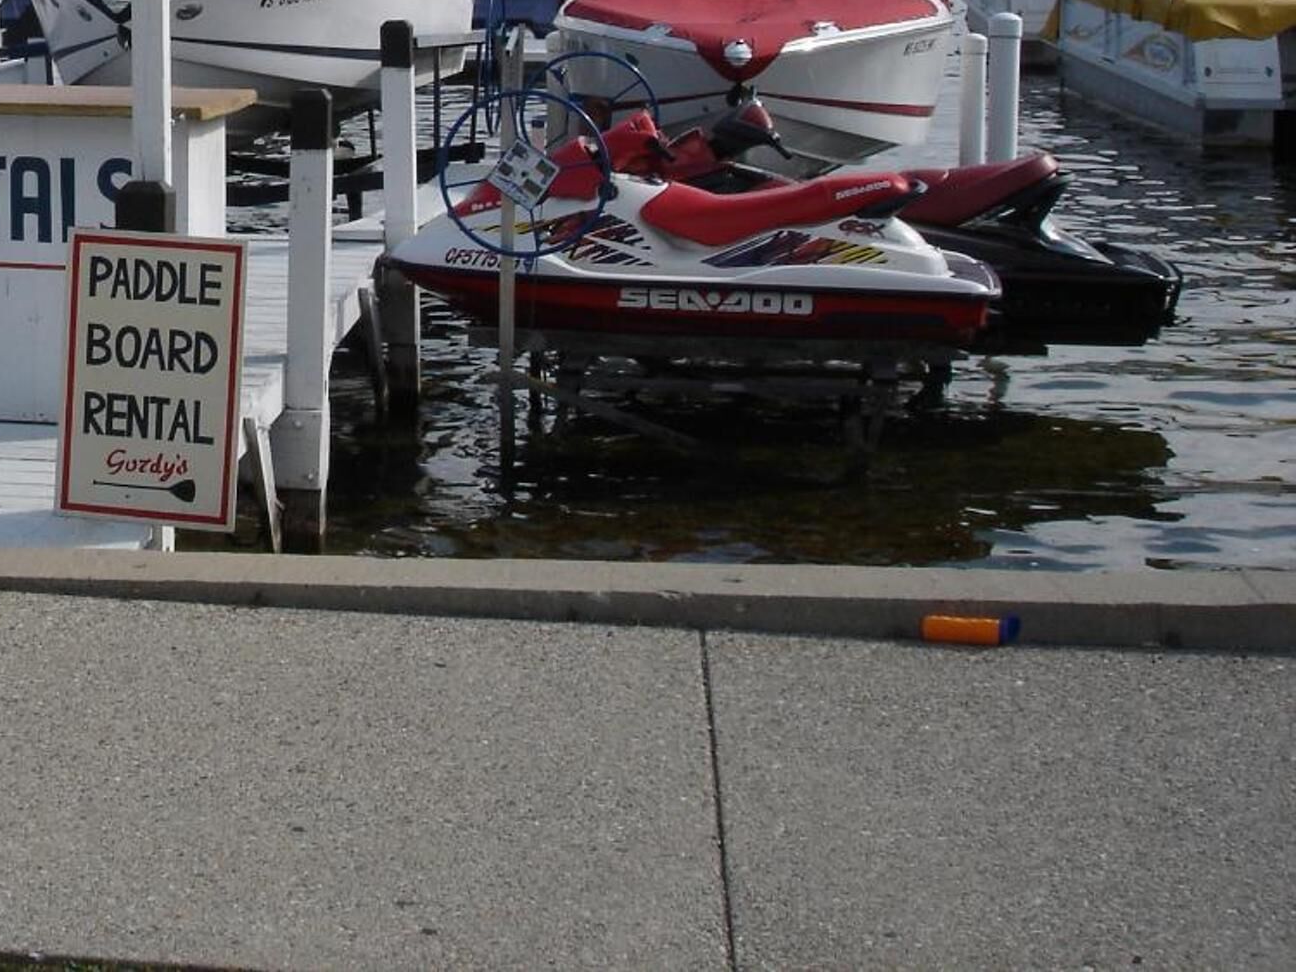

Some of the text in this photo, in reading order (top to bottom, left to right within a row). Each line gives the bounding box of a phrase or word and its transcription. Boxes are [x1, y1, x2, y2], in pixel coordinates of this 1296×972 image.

[89, 256, 223, 306] PADDLE
[86, 323, 218, 375] BOARD
[83, 391, 215, 445] RENTAL
[106, 449, 188, 482] Gordy's
